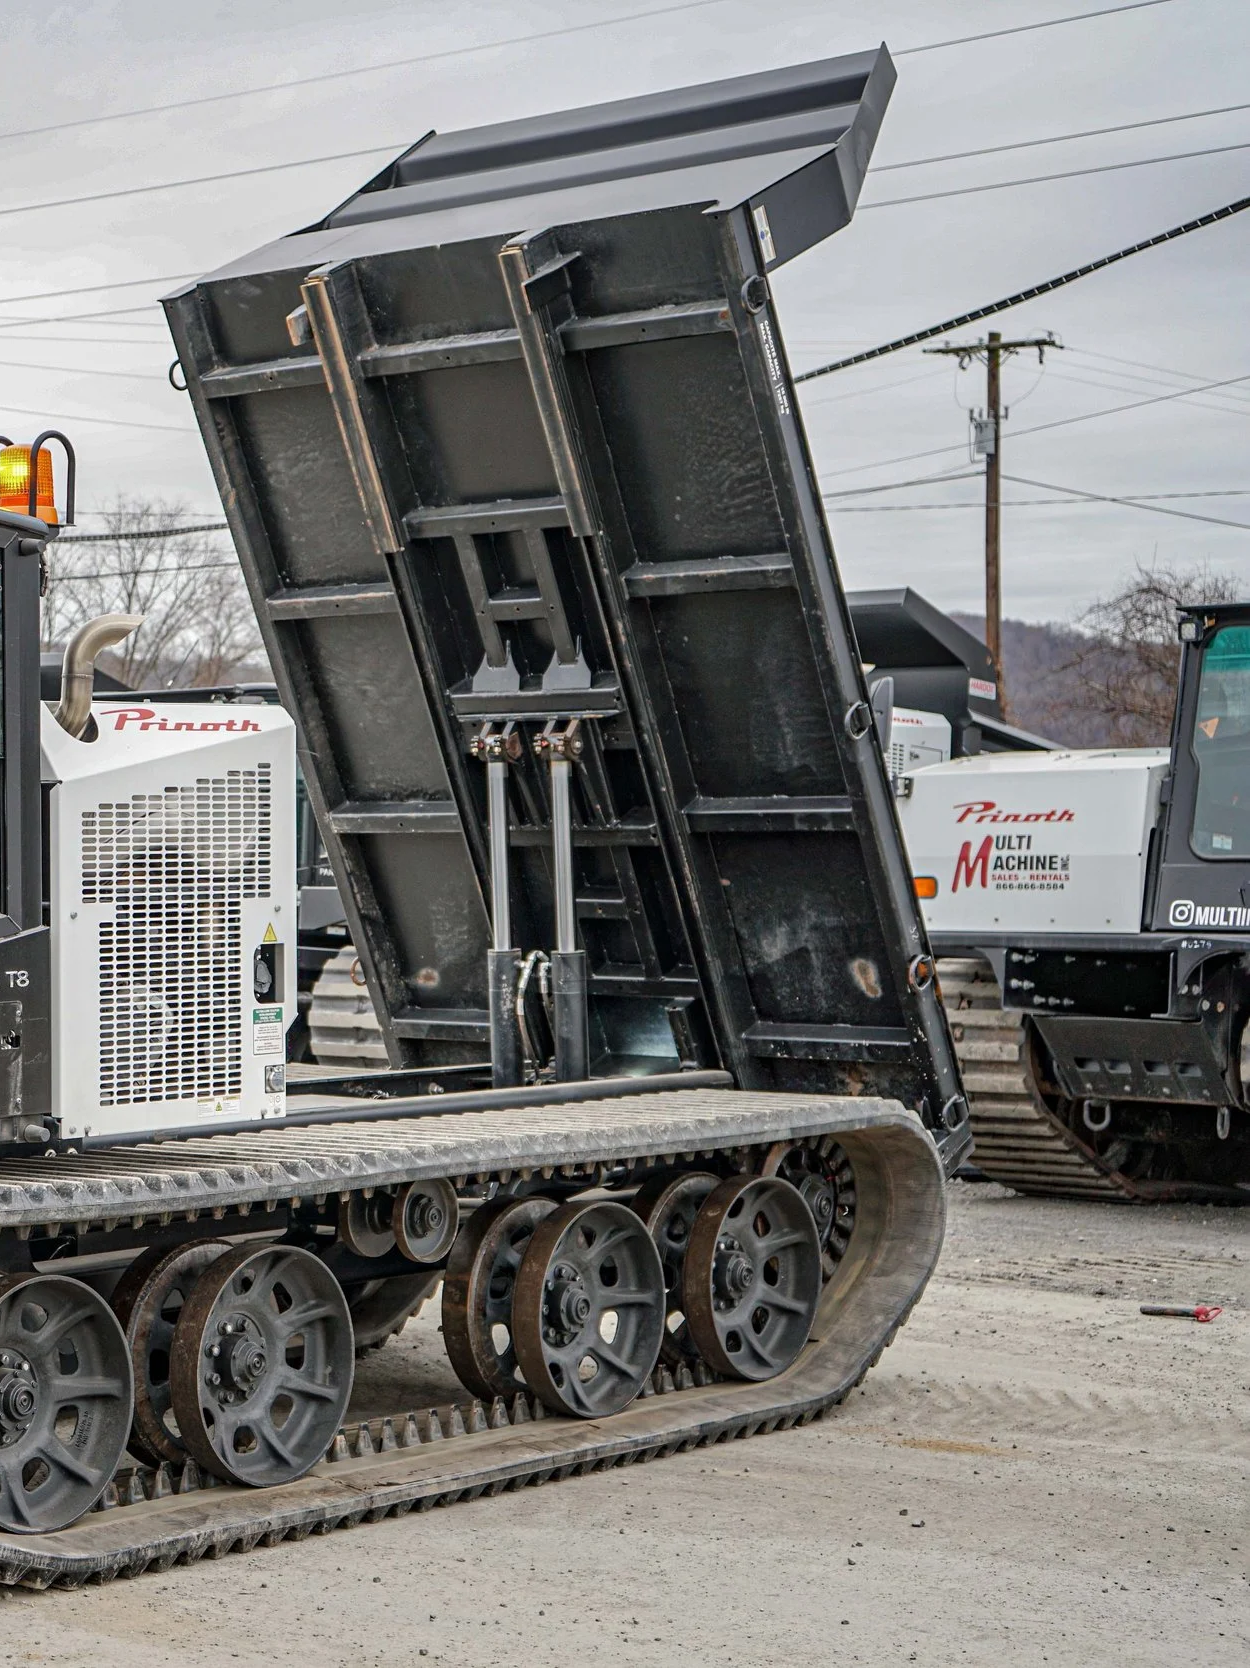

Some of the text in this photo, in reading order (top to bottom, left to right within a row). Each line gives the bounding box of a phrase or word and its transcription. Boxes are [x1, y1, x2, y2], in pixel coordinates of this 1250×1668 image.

[100, 708, 262, 732] Prinoth
[953, 801, 1075, 824] Prinoth
[1029, 873, 1070, 881] RENTALS
[4, 970, 30, 988] T8
